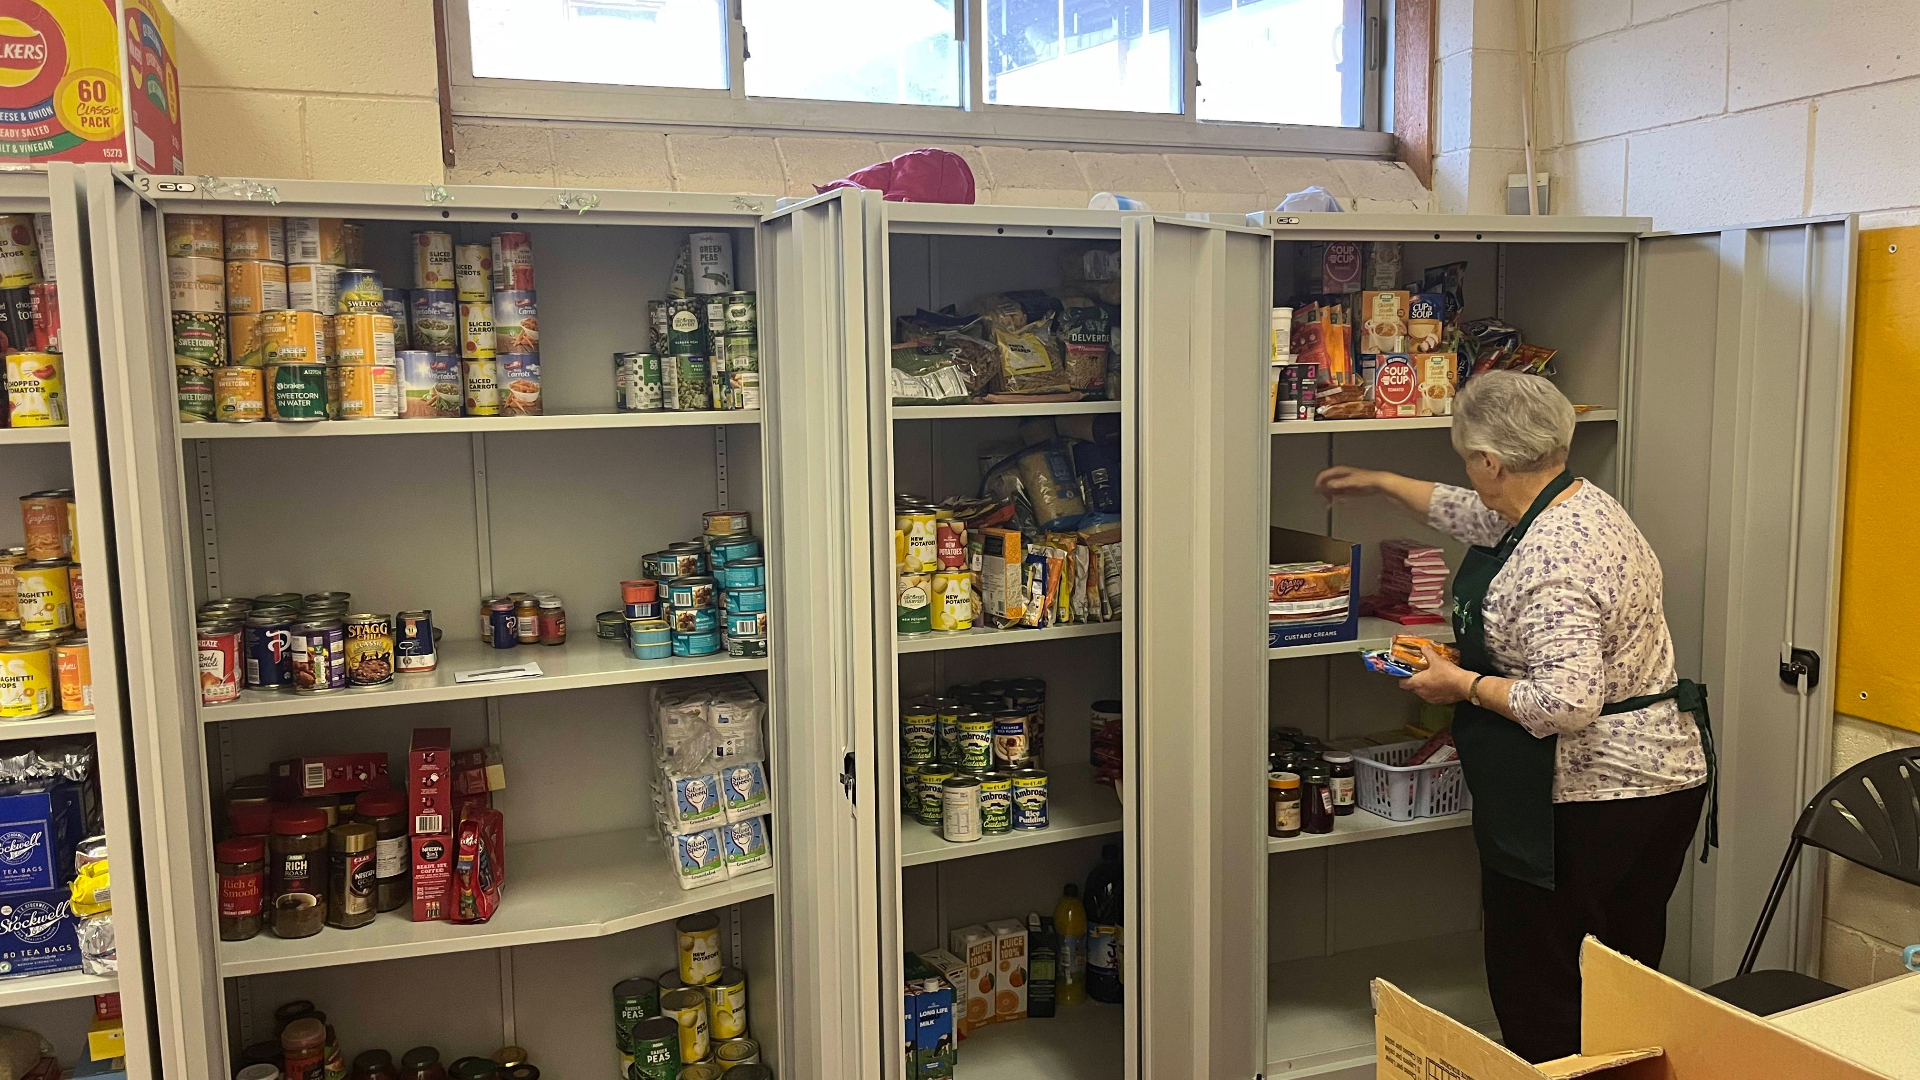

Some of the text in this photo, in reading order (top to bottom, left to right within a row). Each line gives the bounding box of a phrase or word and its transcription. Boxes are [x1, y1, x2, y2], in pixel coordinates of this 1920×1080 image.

[0, 43, 44, 60] KERS
[77, 80, 107, 103] 60
[20, 112, 27, 121] &
[28, 106, 54, 121] ONION
[81, 117, 111, 128] PACK
[21, 125, 50, 138] SALTED
[12, 141, 54, 153] & VINEGAR
[103, 149, 123, 158] 15273
[139, 177, 150, 192] 3
[699, 245, 722, 253] GREEN
[1330, 245, 1355, 255] SOUP
[700, 253, 719, 262] PEAS
[1336, 254, 1355, 264] CUP
[1411, 310, 1433, 319] SOUP
[1071, 333, 1111, 342] DELVERDE
[178, 339, 214, 347] SWEETCORN
[1384, 366, 1409, 376] SOUP
[1389, 375, 1410, 385] CUP
[283, 382, 306, 390] brakes
[178, 393, 214, 401] SWEETCORN
[276, 392, 319, 400] SWEETCORN
[945, 541, 956, 549] NEW
[938, 547, 963, 556] POTATOES
[347, 622, 389, 639] STAGG
[1284, 630, 1337, 641] CUSTARD CREAMS
[907, 750, 932, 759] Custard
[965, 754, 985, 762] Devon
[961, 759, 987, 767] Custard
[921, 806, 941, 814] Devon
[1025, 809, 1040, 818] Rice
[986, 814, 1006, 822] Devon
[1018, 815, 1046, 824] Pudding
[983, 820, 1009, 828] Custard
[2, 865, 43, 876] TEA BAGS
[285, 860, 308, 871] RICH
[223, 877, 258, 889] Rich &
[357, 876, 375, 886] GOLD
[223, 886, 259, 898] Smooth
[1001, 937, 1023, 949] JUICE
[3, 952, 16, 960] 80
[20, 948, 41, 957] TEA
[44, 944, 73, 954] BAGS
[971, 942, 991, 956] JUICE
[1000, 947, 1020, 959] 100%
[970, 952, 989, 967] 100%
[622, 1009, 644, 1019] PEAS
[919, 1009, 936, 1018] LONG
[696, 1021, 706, 1030] NEW
[919, 1019, 935, 1028] MILK
[647, 1051, 671, 1063] PEAS
